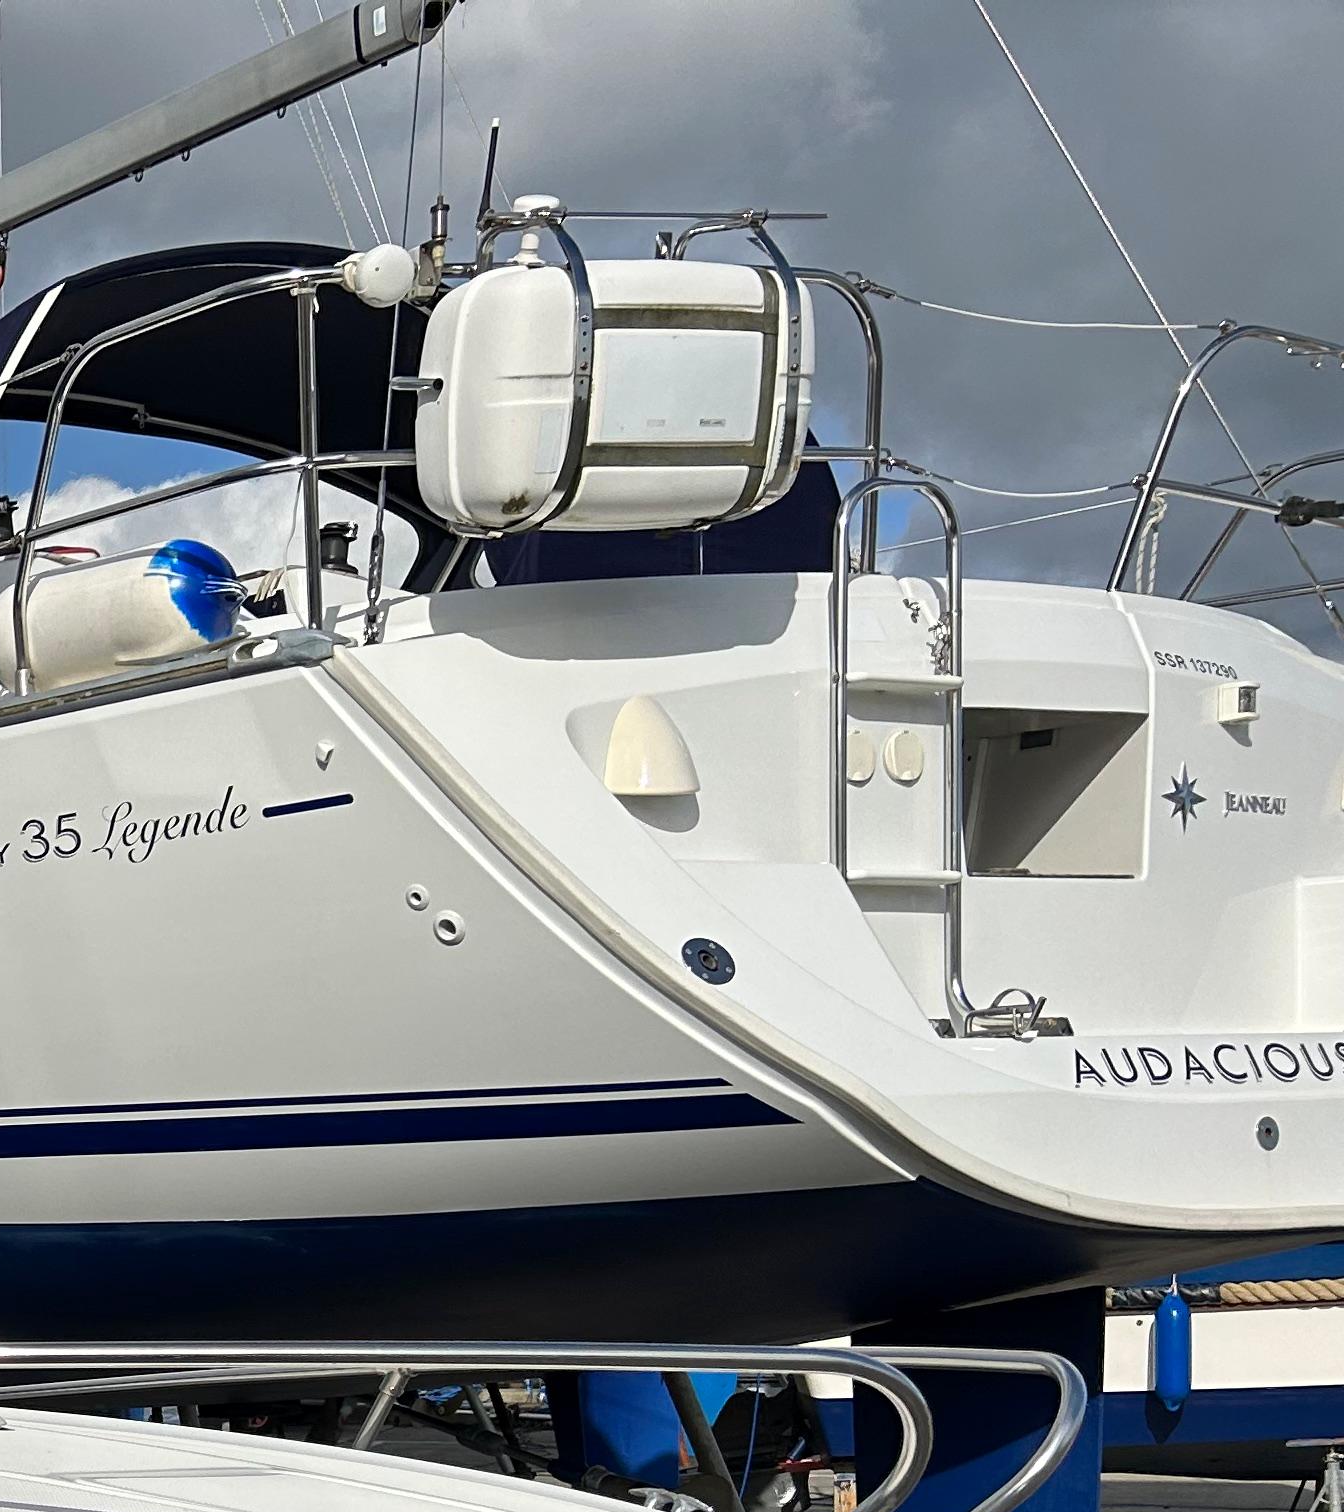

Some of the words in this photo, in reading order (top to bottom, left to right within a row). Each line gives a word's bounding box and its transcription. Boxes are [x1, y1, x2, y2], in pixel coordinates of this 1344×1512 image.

[1154, 651, 1188, 670] SSR
[1189, 658, 1238, 680] 137290
[1224, 791, 1287, 818] JEANNEAU
[20, 813, 82, 864] 35
[91, 786, 251, 864] Legende
